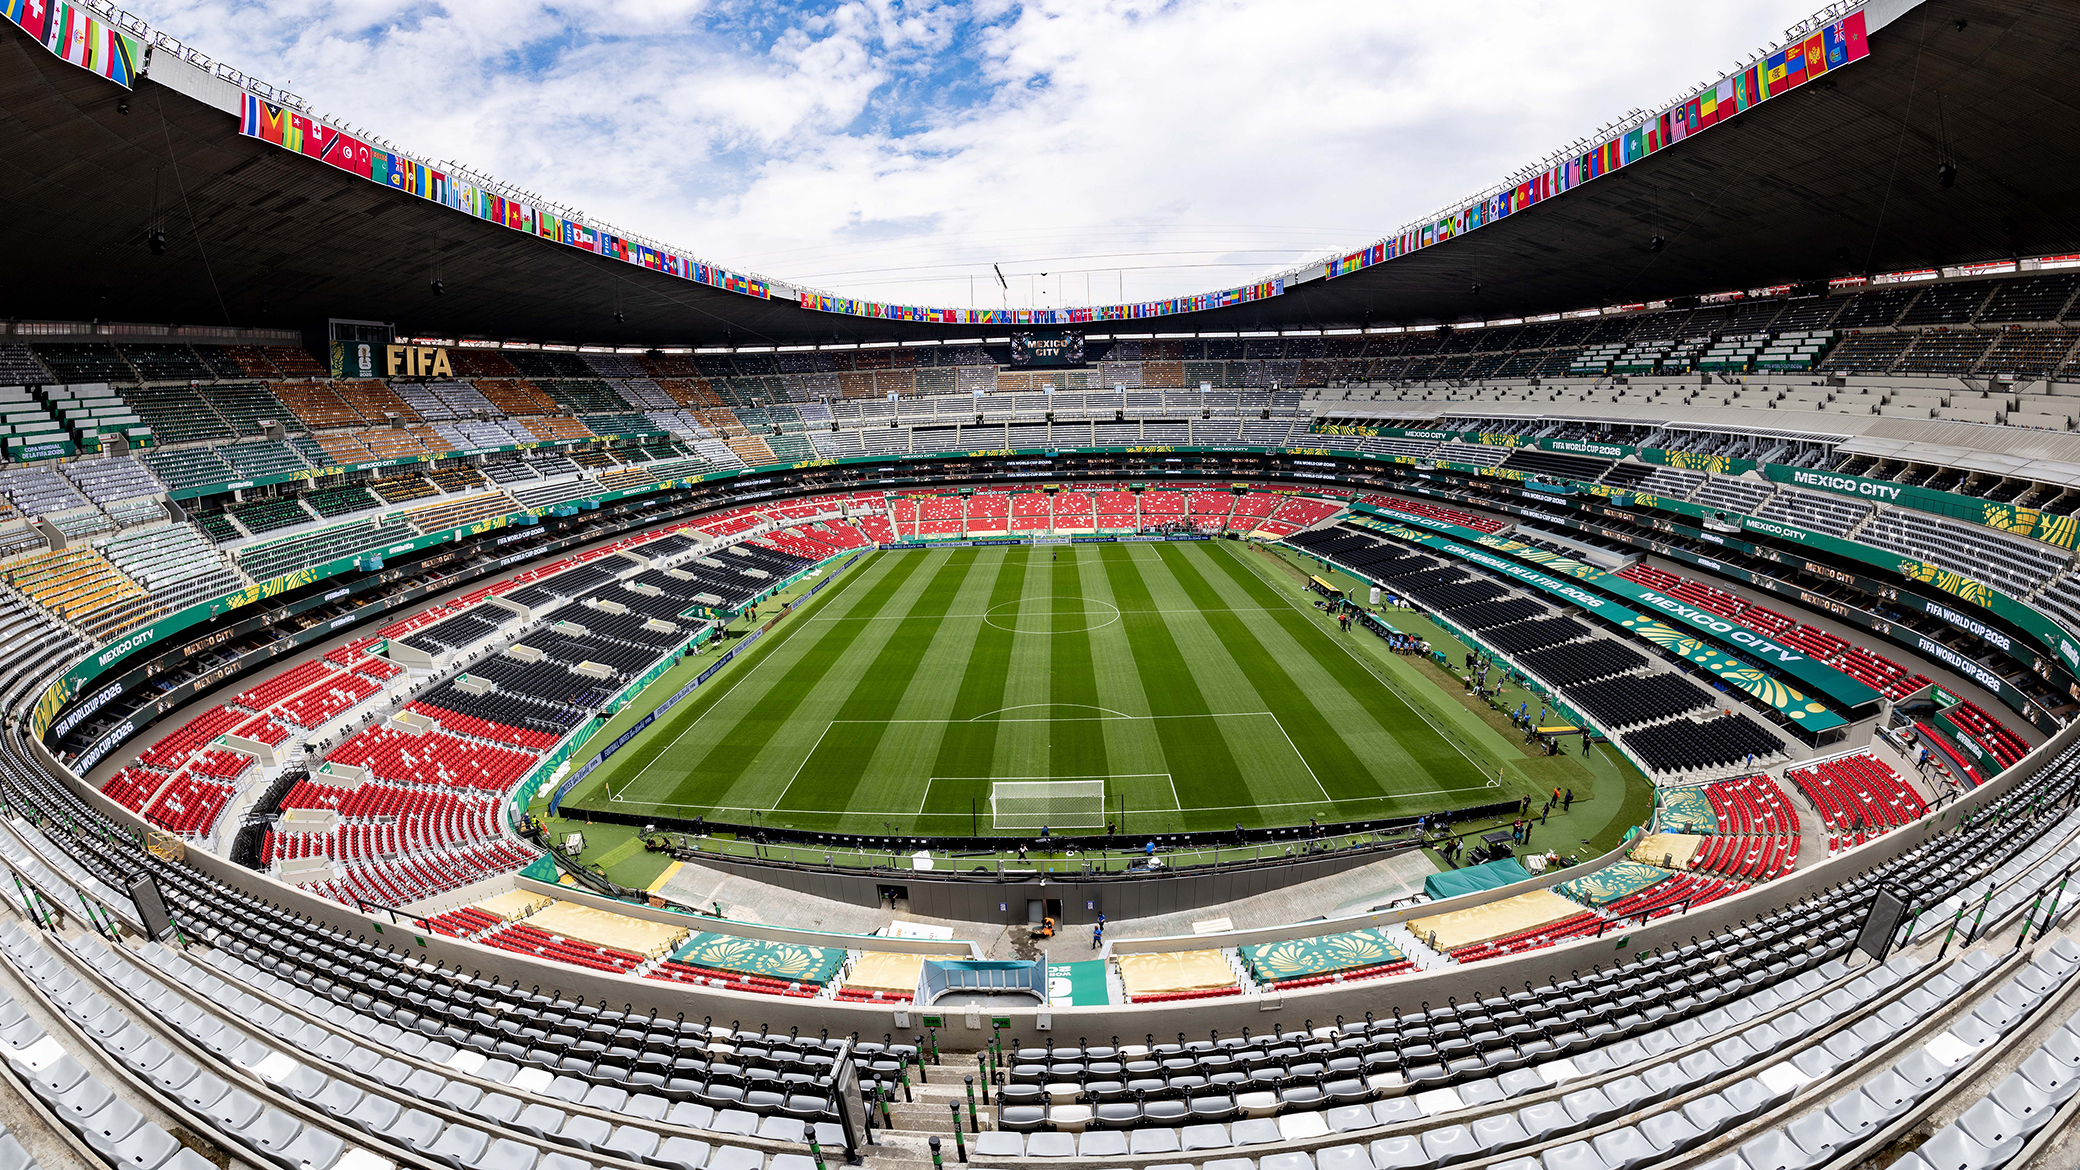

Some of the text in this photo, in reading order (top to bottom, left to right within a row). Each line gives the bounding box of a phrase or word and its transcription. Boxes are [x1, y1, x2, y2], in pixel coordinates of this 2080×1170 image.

[1028, 340, 1068, 348] MEXICO
[387, 345, 453, 376] FIFA
[1553, 441, 1621, 456] FIFA WORLD CUP 2026
[357, 461, 382, 469] MEXICO
[1794, 471, 1901, 500] MEXICO CITY
[1375, 509, 1453, 529] MEXICO CITY
[1746, 519, 1806, 541] MEXICO CITY
[1443, 545, 1604, 608] COPA MUNDIAL DE LA FIFA 2026
[1805, 562, 1855, 584] MEXICO CITY
[1800, 592, 1849, 616] MEXICO CITY
[1638, 592, 1803, 662] MEXICO CITY
[1926, 602, 2010, 650] FIFA WORLD CUP 2026
[99, 629, 154, 666] MEXICO CITY
[184, 629, 234, 656] MEXICO CITY
[194, 661, 242, 691] MEXICO CITY
[1918, 638, 2000, 692] FIFA WORLD CUP 2026
[55, 724, 70, 738] FIFA
[67, 706, 91, 727] WORLD
[99, 683, 123, 705] 2026
[99, 737, 112, 753] CUP
[111, 721, 134, 744] 2026
[604, 742, 620, 757] FOOTBALL
[618, 733, 631, 745] UNITES
